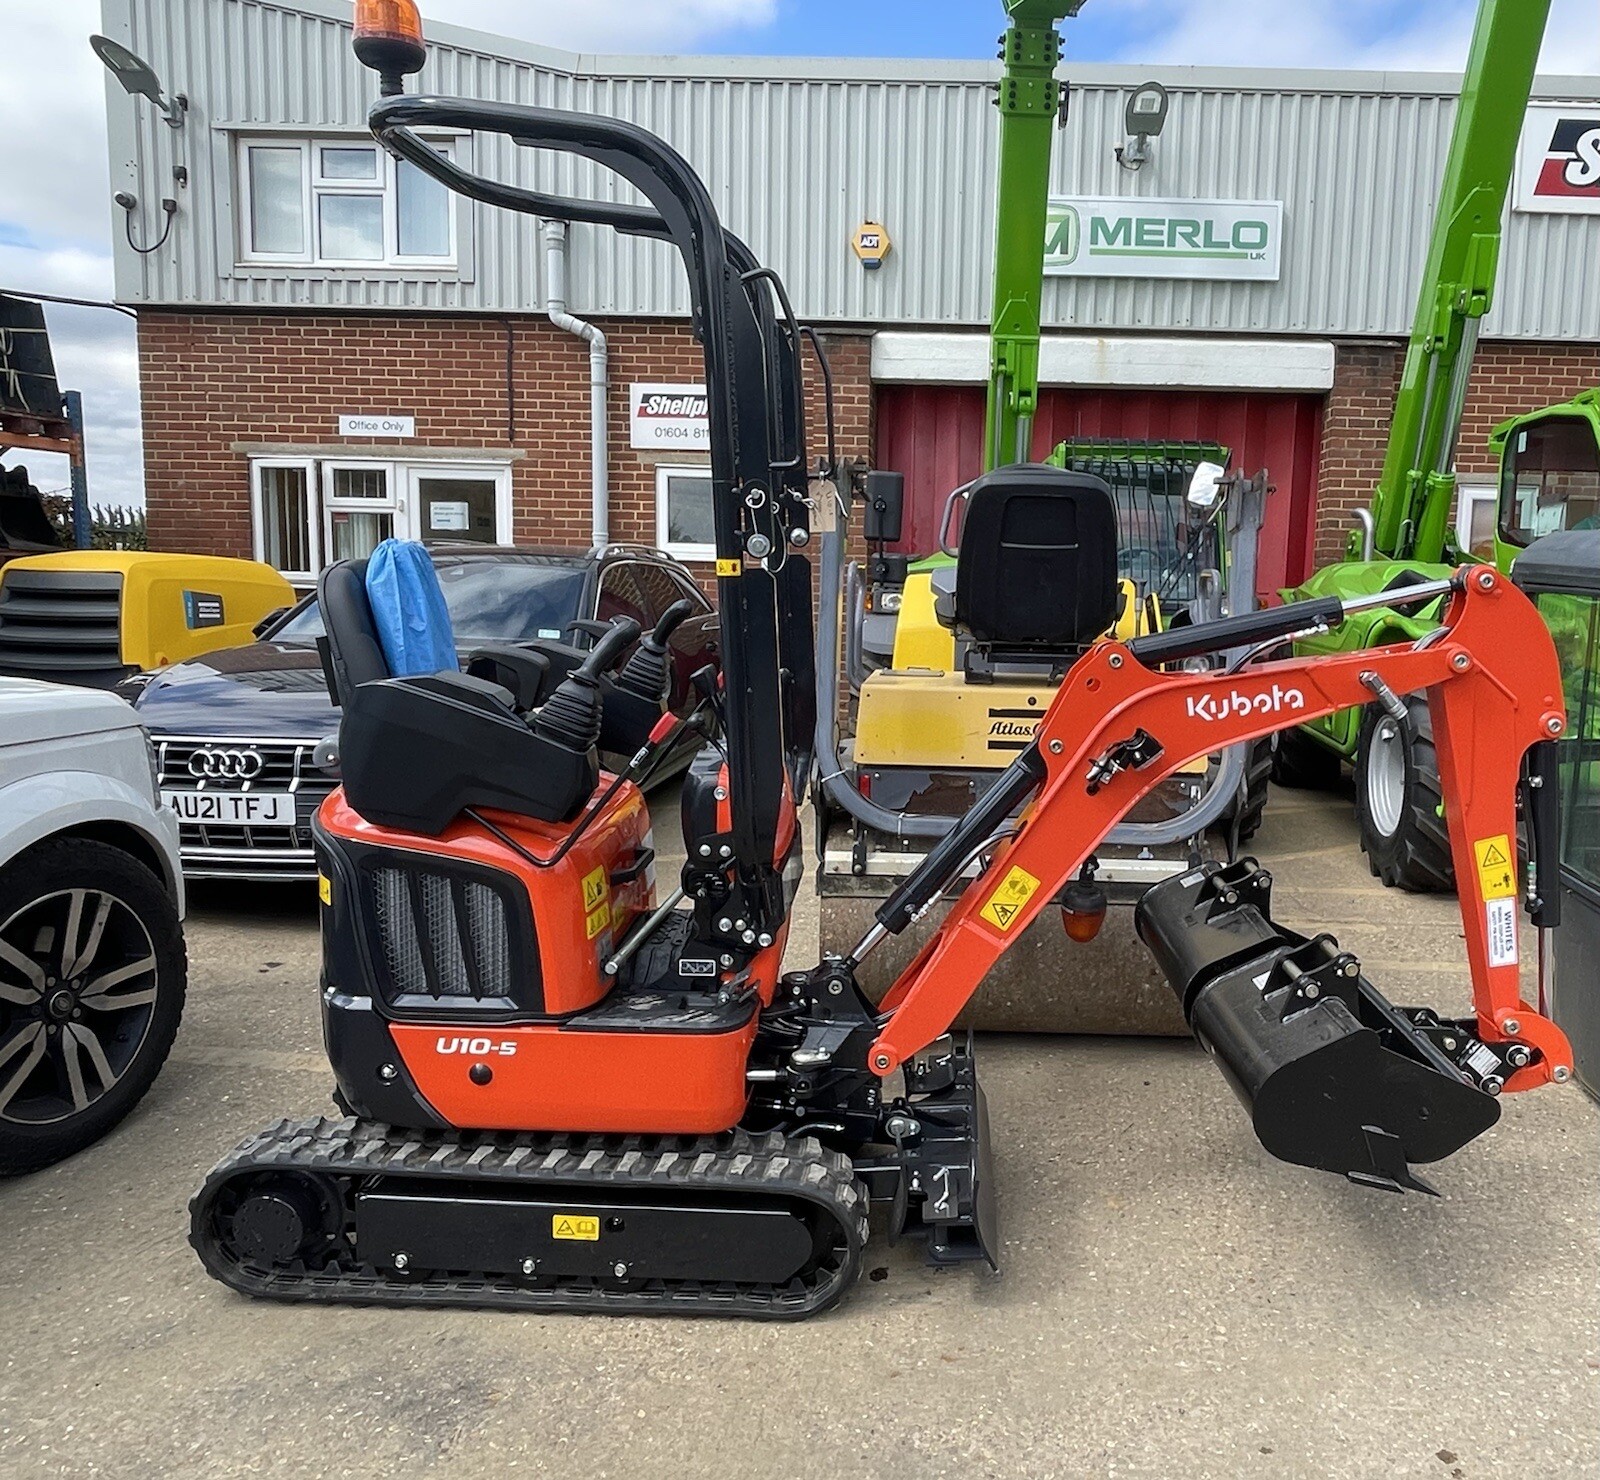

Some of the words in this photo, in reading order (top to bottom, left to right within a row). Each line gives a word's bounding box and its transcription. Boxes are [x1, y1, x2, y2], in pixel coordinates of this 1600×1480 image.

[860, 235, 880, 247] ADT
[1090, 216, 1268, 249] MERLO
[1250, 252, 1266, 260] UK
[349, 420, 378, 430] Office
[382, 421, 404, 432] Only
[654, 427, 688, 438] 01604
[1186, 684, 1304, 721] Kubota
[172, 796, 221, 818] AU21
[229, 797, 278, 819] TFJ
[1504, 911, 1513, 952] WHITES
[436, 1037, 517, 1056] U10-5
